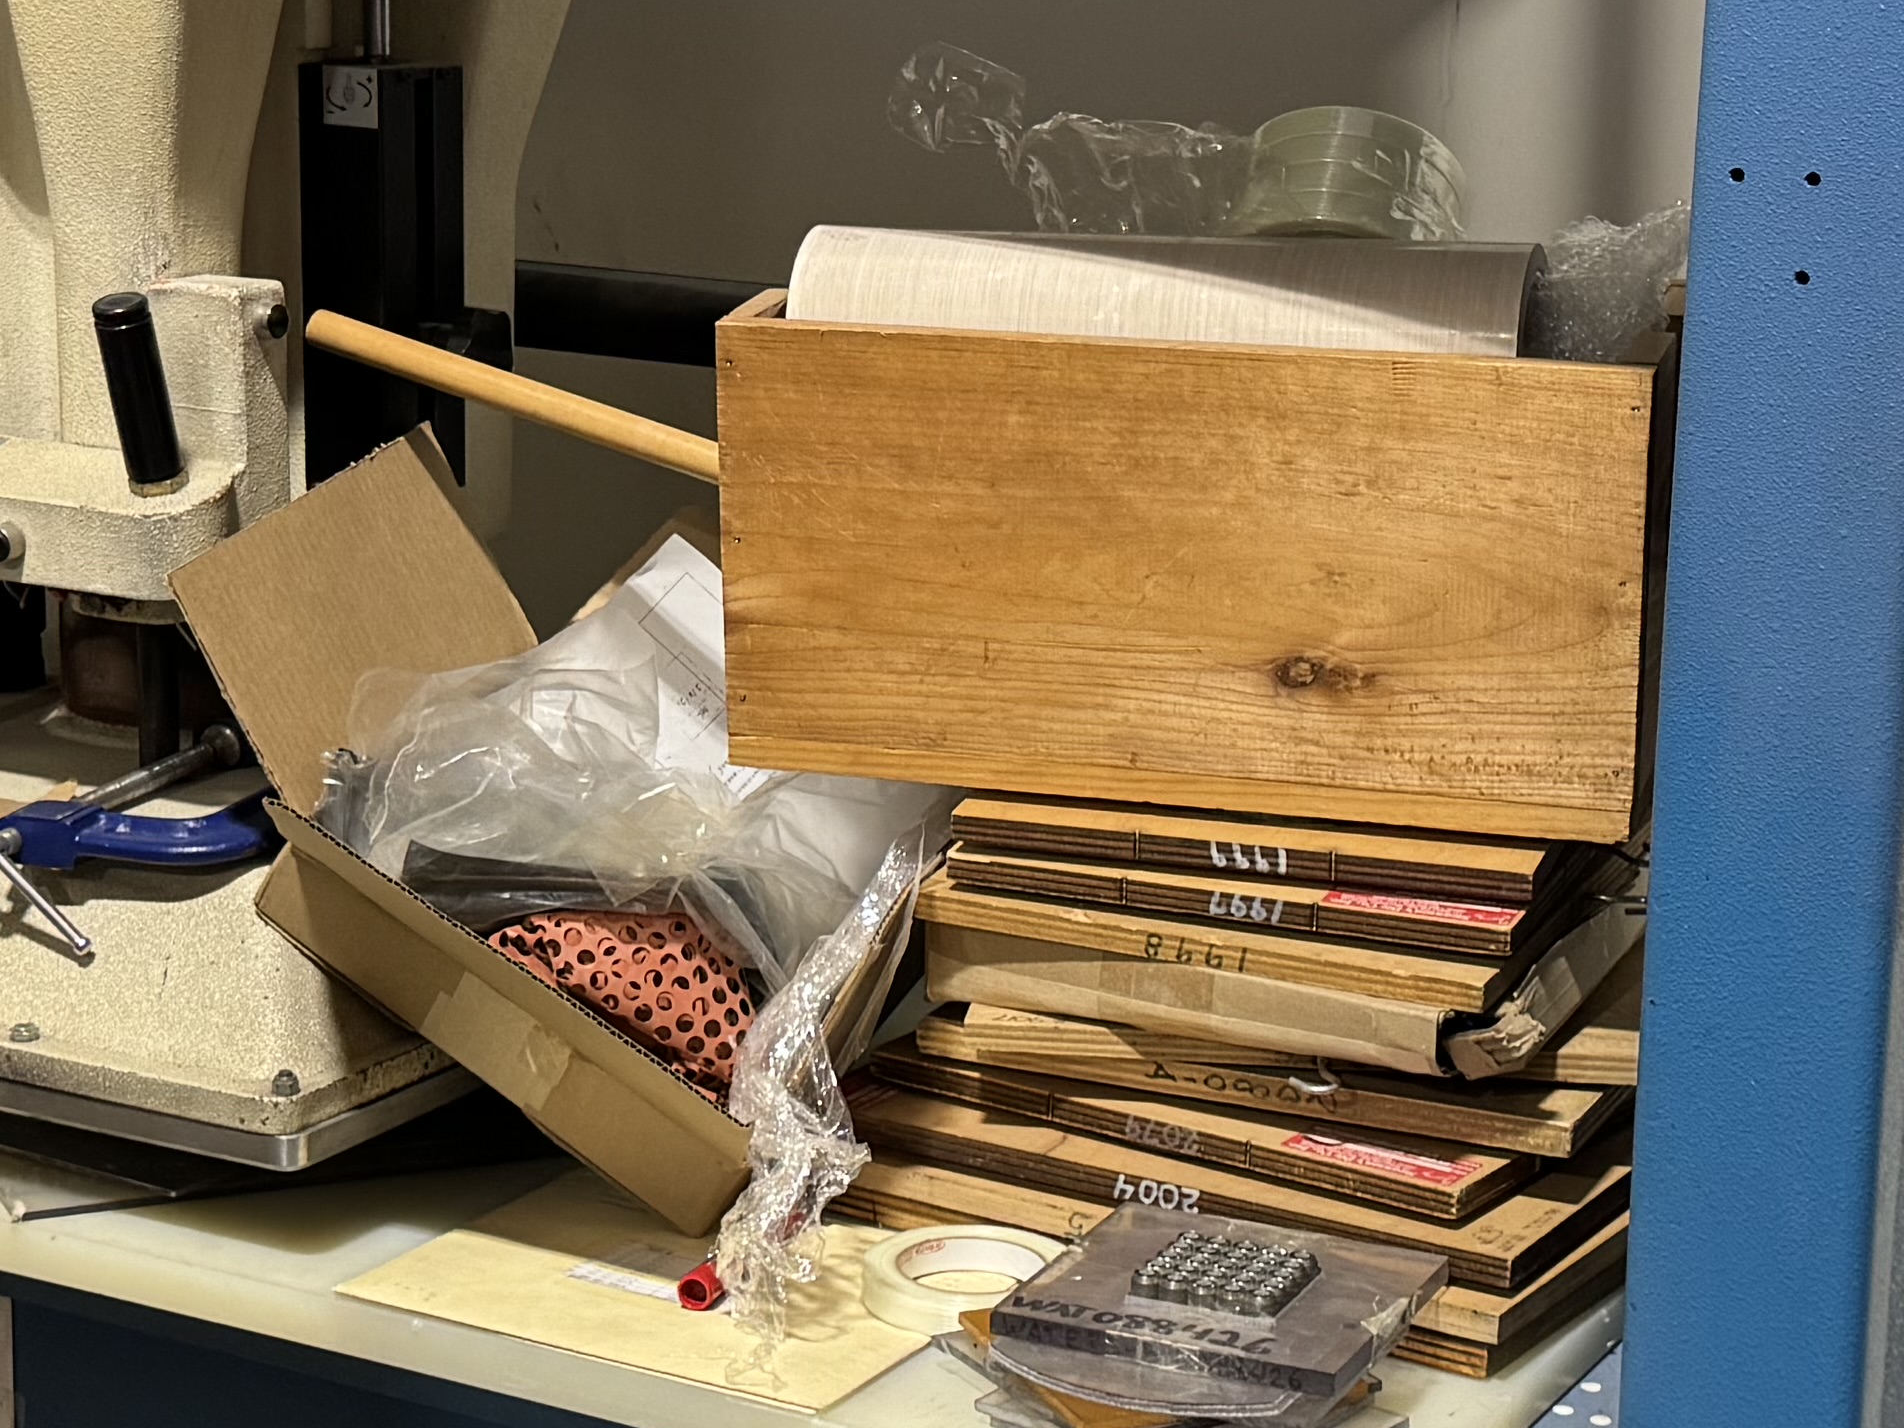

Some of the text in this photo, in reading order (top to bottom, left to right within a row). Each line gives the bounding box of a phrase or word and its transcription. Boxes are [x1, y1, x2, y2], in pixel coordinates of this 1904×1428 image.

[1210, 841, 1287, 875] 1999
[1209, 891, 1284, 924] 1997
[1145, 932, 1247, 973] 1998
[1113, 1174, 1200, 1214] 2004
